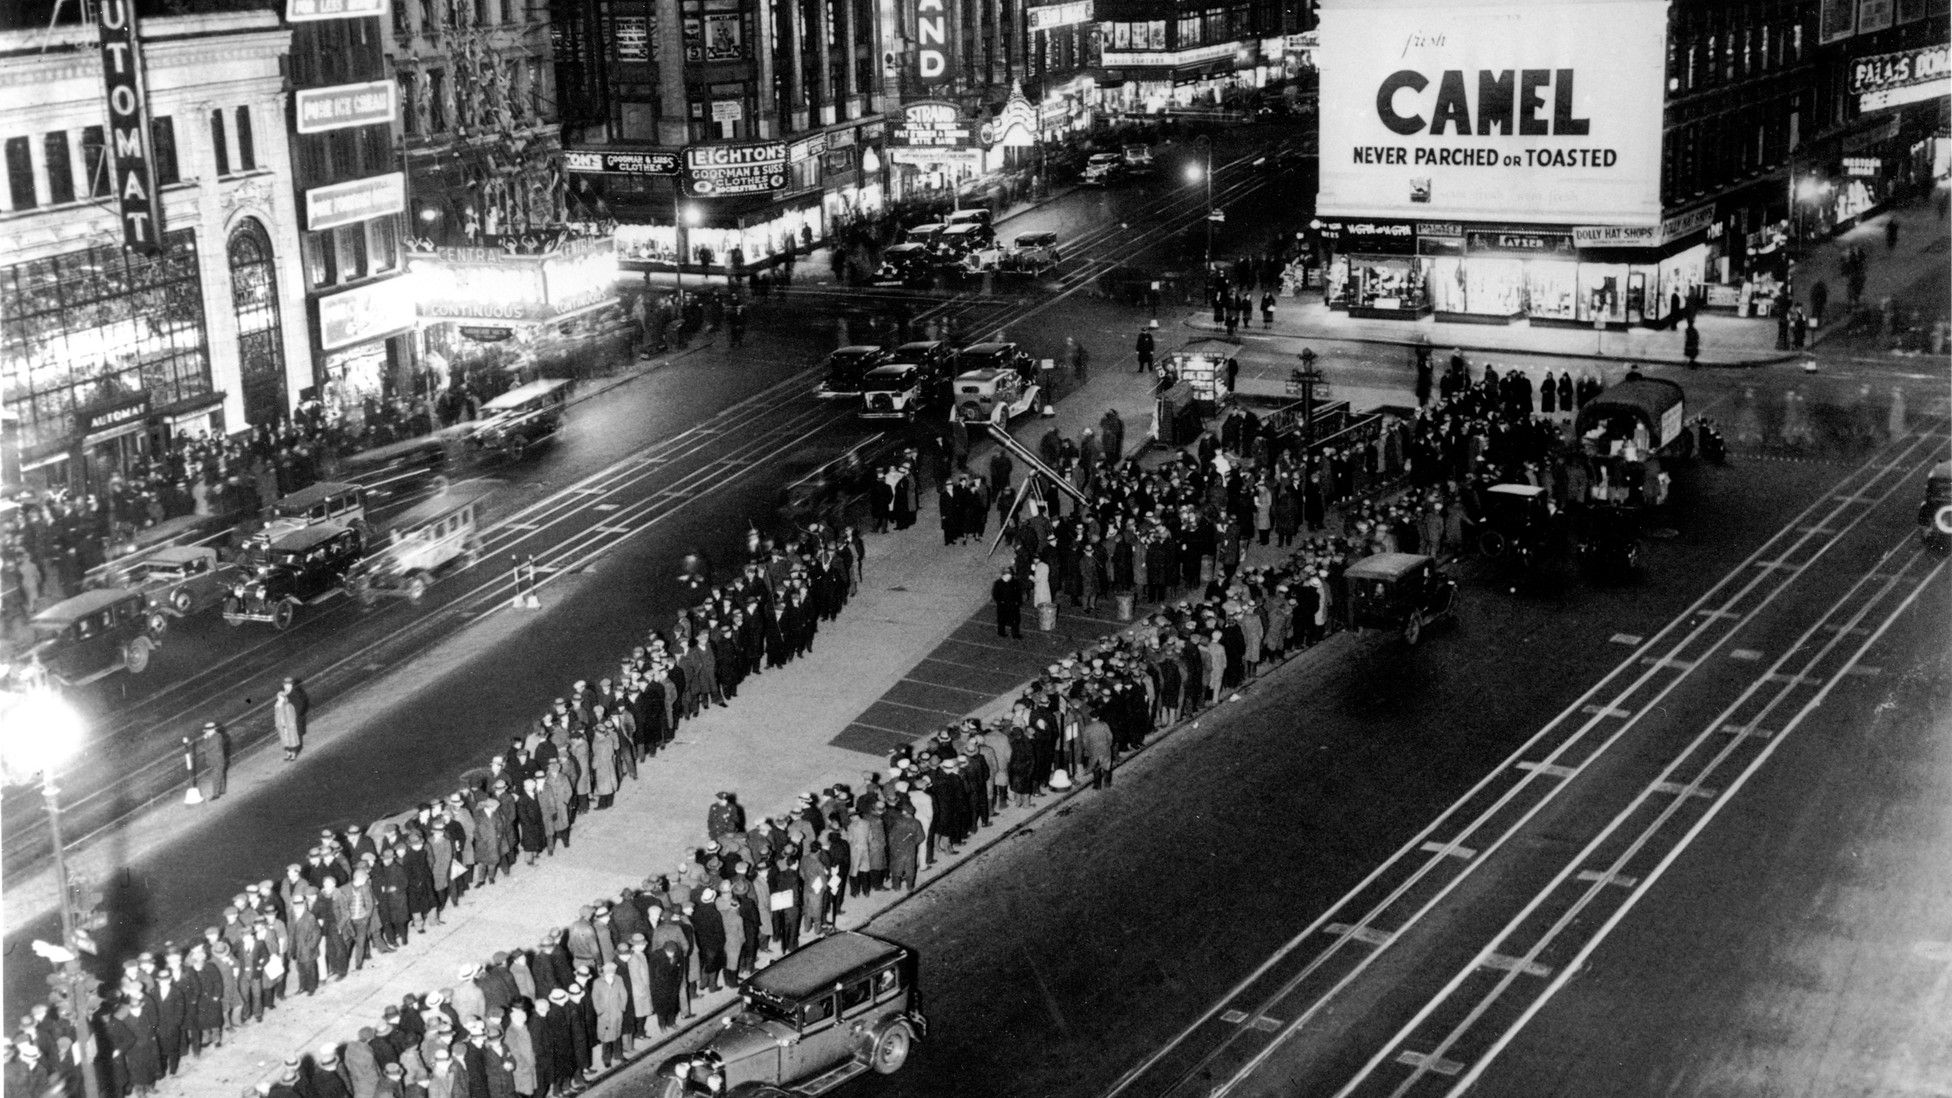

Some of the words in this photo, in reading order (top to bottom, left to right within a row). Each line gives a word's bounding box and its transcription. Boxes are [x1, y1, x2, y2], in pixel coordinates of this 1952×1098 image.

[1376, 68, 1590, 136] CAMEL
[906, 104, 956, 123] STRAND
[688, 144, 786, 169] LEIGHTON'S
[1353, 147, 1407, 165] NEVER
[1415, 147, 1499, 167] PARCHED
[1503, 155, 1521, 167] OR
[1525, 149, 1617, 168] TOASTED
[692, 167, 750, 179] GOODMAN
[753, 166, 760, 176] &
[762, 163, 784, 175] SUSS
[716, 175, 768, 187] CLOTHES
[1499, 234, 1544, 249] KAYSER
[1576, 229, 1602, 240] DOLLY
[1605, 228, 1621, 239] HAT
[1624, 227, 1653, 239] SHOPS
[437, 246, 504, 263] CENTRAL
[431, 304, 522, 318] CONTINUOUS
[91, 403, 145, 428] AUTOMAT
